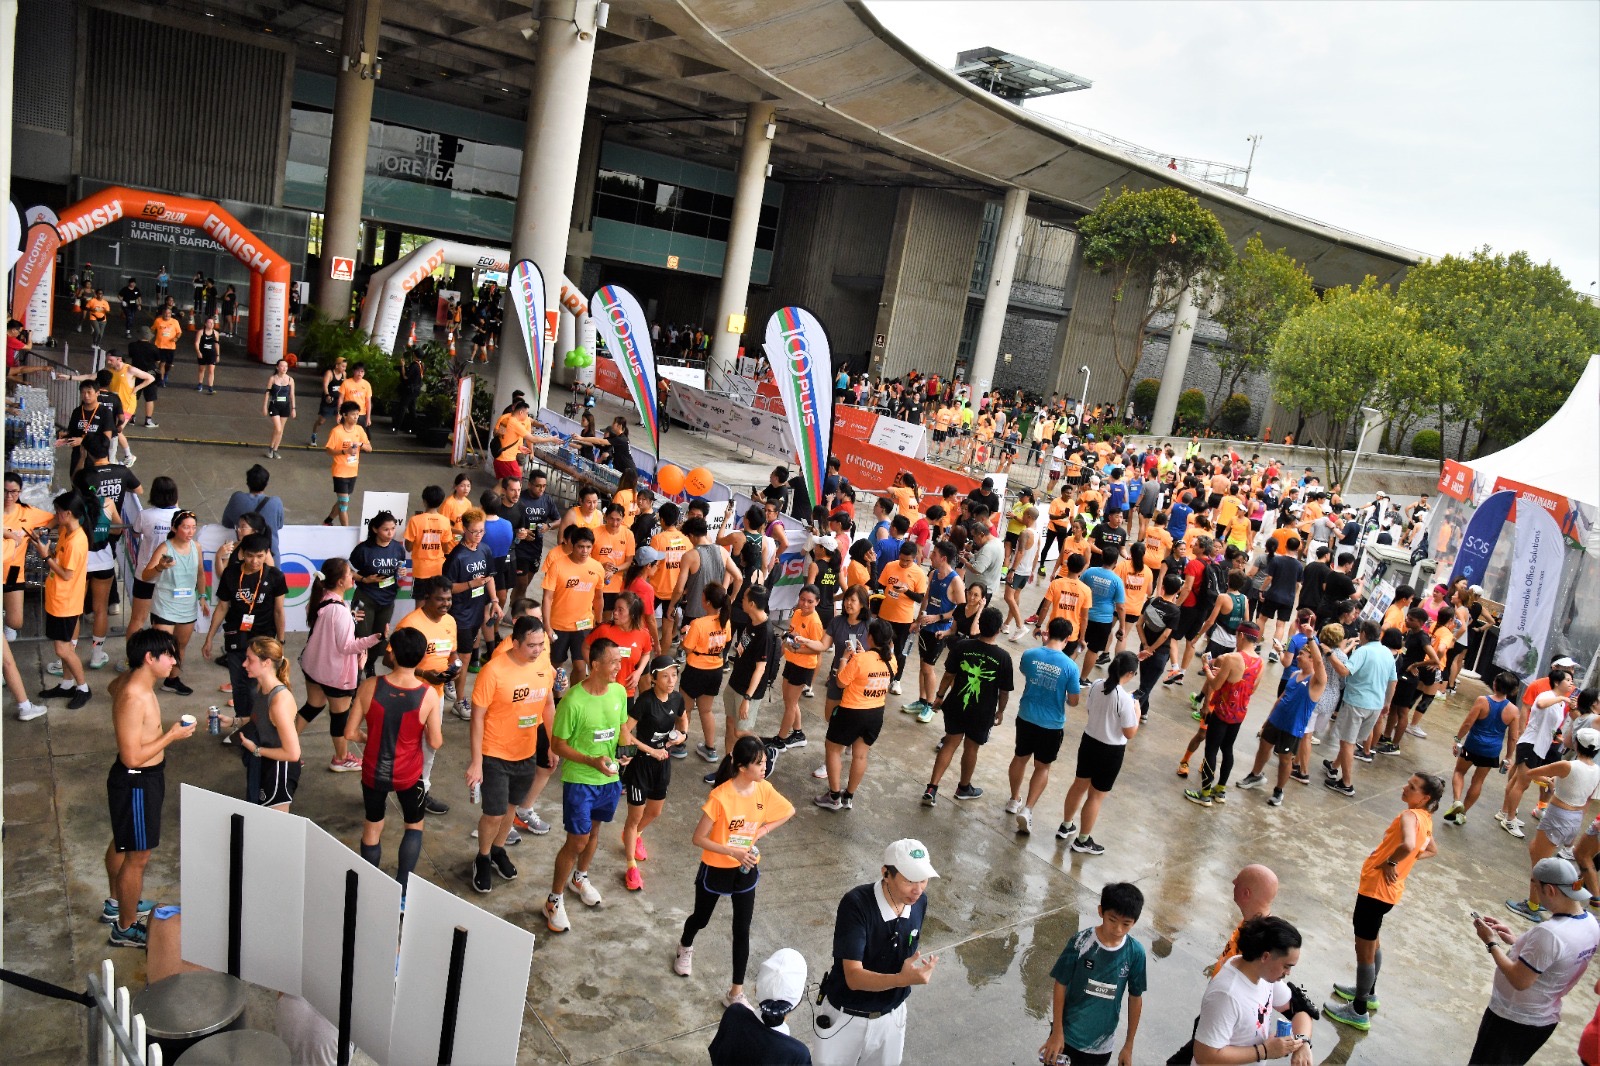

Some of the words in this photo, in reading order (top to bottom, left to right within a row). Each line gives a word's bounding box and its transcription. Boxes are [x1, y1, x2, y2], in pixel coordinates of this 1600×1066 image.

[143, 204, 165, 217] ECO
[161, 211, 188, 223] RUN
[138, 222, 181, 234] BENEFITS
[183, 228, 196, 236] OF
[130, 229, 176, 244] MARINA
[179, 237, 228, 251] BARRAG
[203, 213, 272, 275] FINISH
[109, 242, 120, 265] 1
[477, 256, 496, 267] ECO
[402, 248, 445, 293] START
[560, 285, 589, 318] ART
[853, 453, 884, 475] income
[525, 506, 546, 515] GMG
[1522, 491, 1558, 511] SUSTAINABLE
[599, 547, 612, 556] ECO
[1465, 535, 1490, 554] SOS
[1528, 529, 1542, 564] Solutions
[372, 558, 398, 567] GMG
[466, 560, 487, 573] GMG
[665, 561, 681, 570] WAST
[565, 578, 580, 589] ECO
[1525, 564, 1536, 587] Office
[1517, 587, 1532, 631] Sustainable
[427, 642, 436, 653] EC
[512, 687, 529, 702] ECO
[528, 687, 547, 703] RUN
[728, 819, 744, 831] ECO
